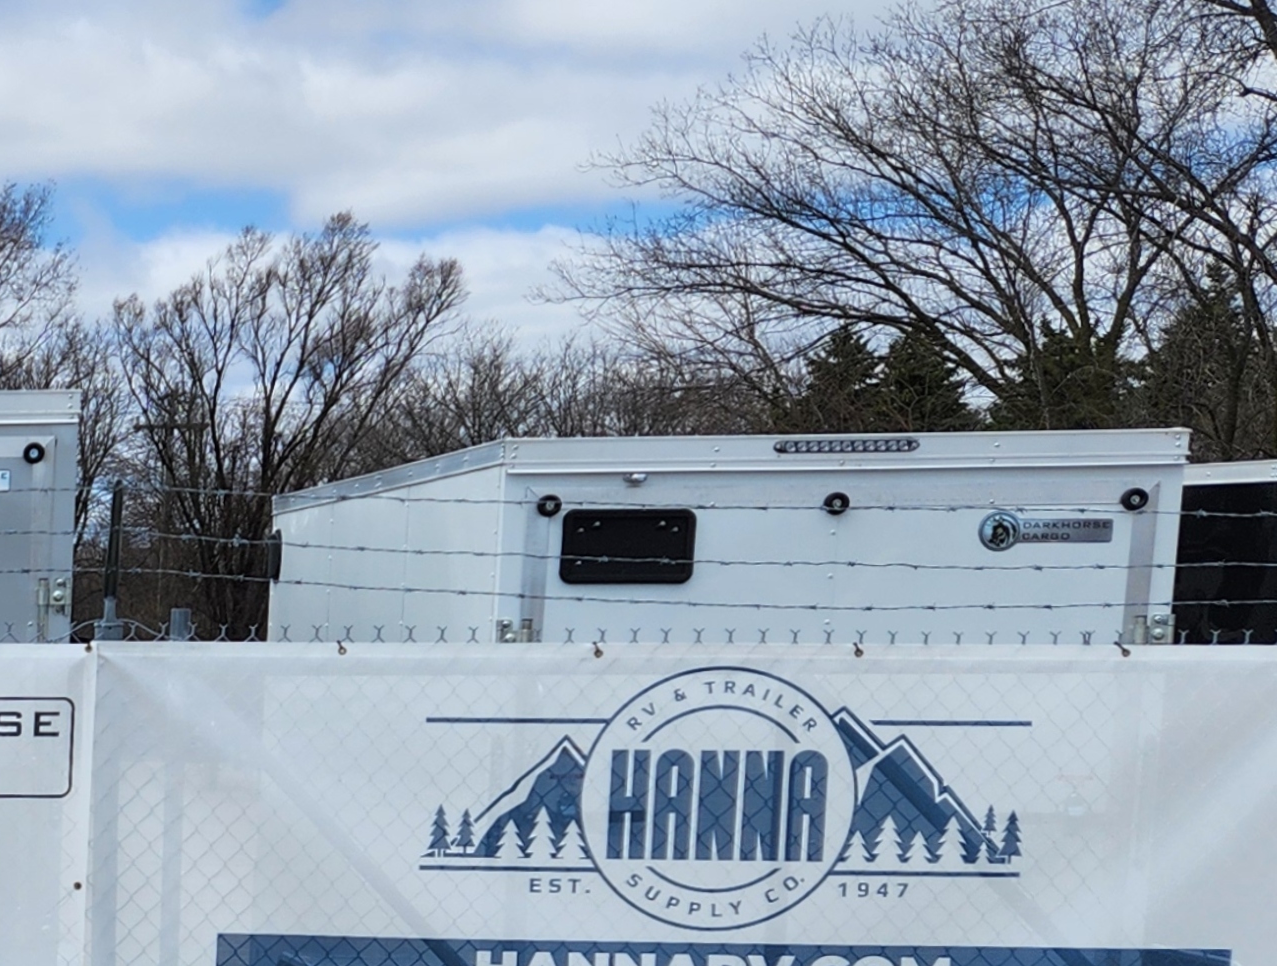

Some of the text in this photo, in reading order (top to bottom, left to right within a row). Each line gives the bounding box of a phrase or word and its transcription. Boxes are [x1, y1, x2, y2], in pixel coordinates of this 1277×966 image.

[1021, 532, 1071, 540] CARGO
[1022, 521, 1111, 529] DARKHORSE
[626, 680, 818, 733] RV & TRAILER
[605, 748, 829, 862] HANNA
[529, 878, 909, 898] EST. 1947
[626, 873, 805, 917] SUPPLY CO.
